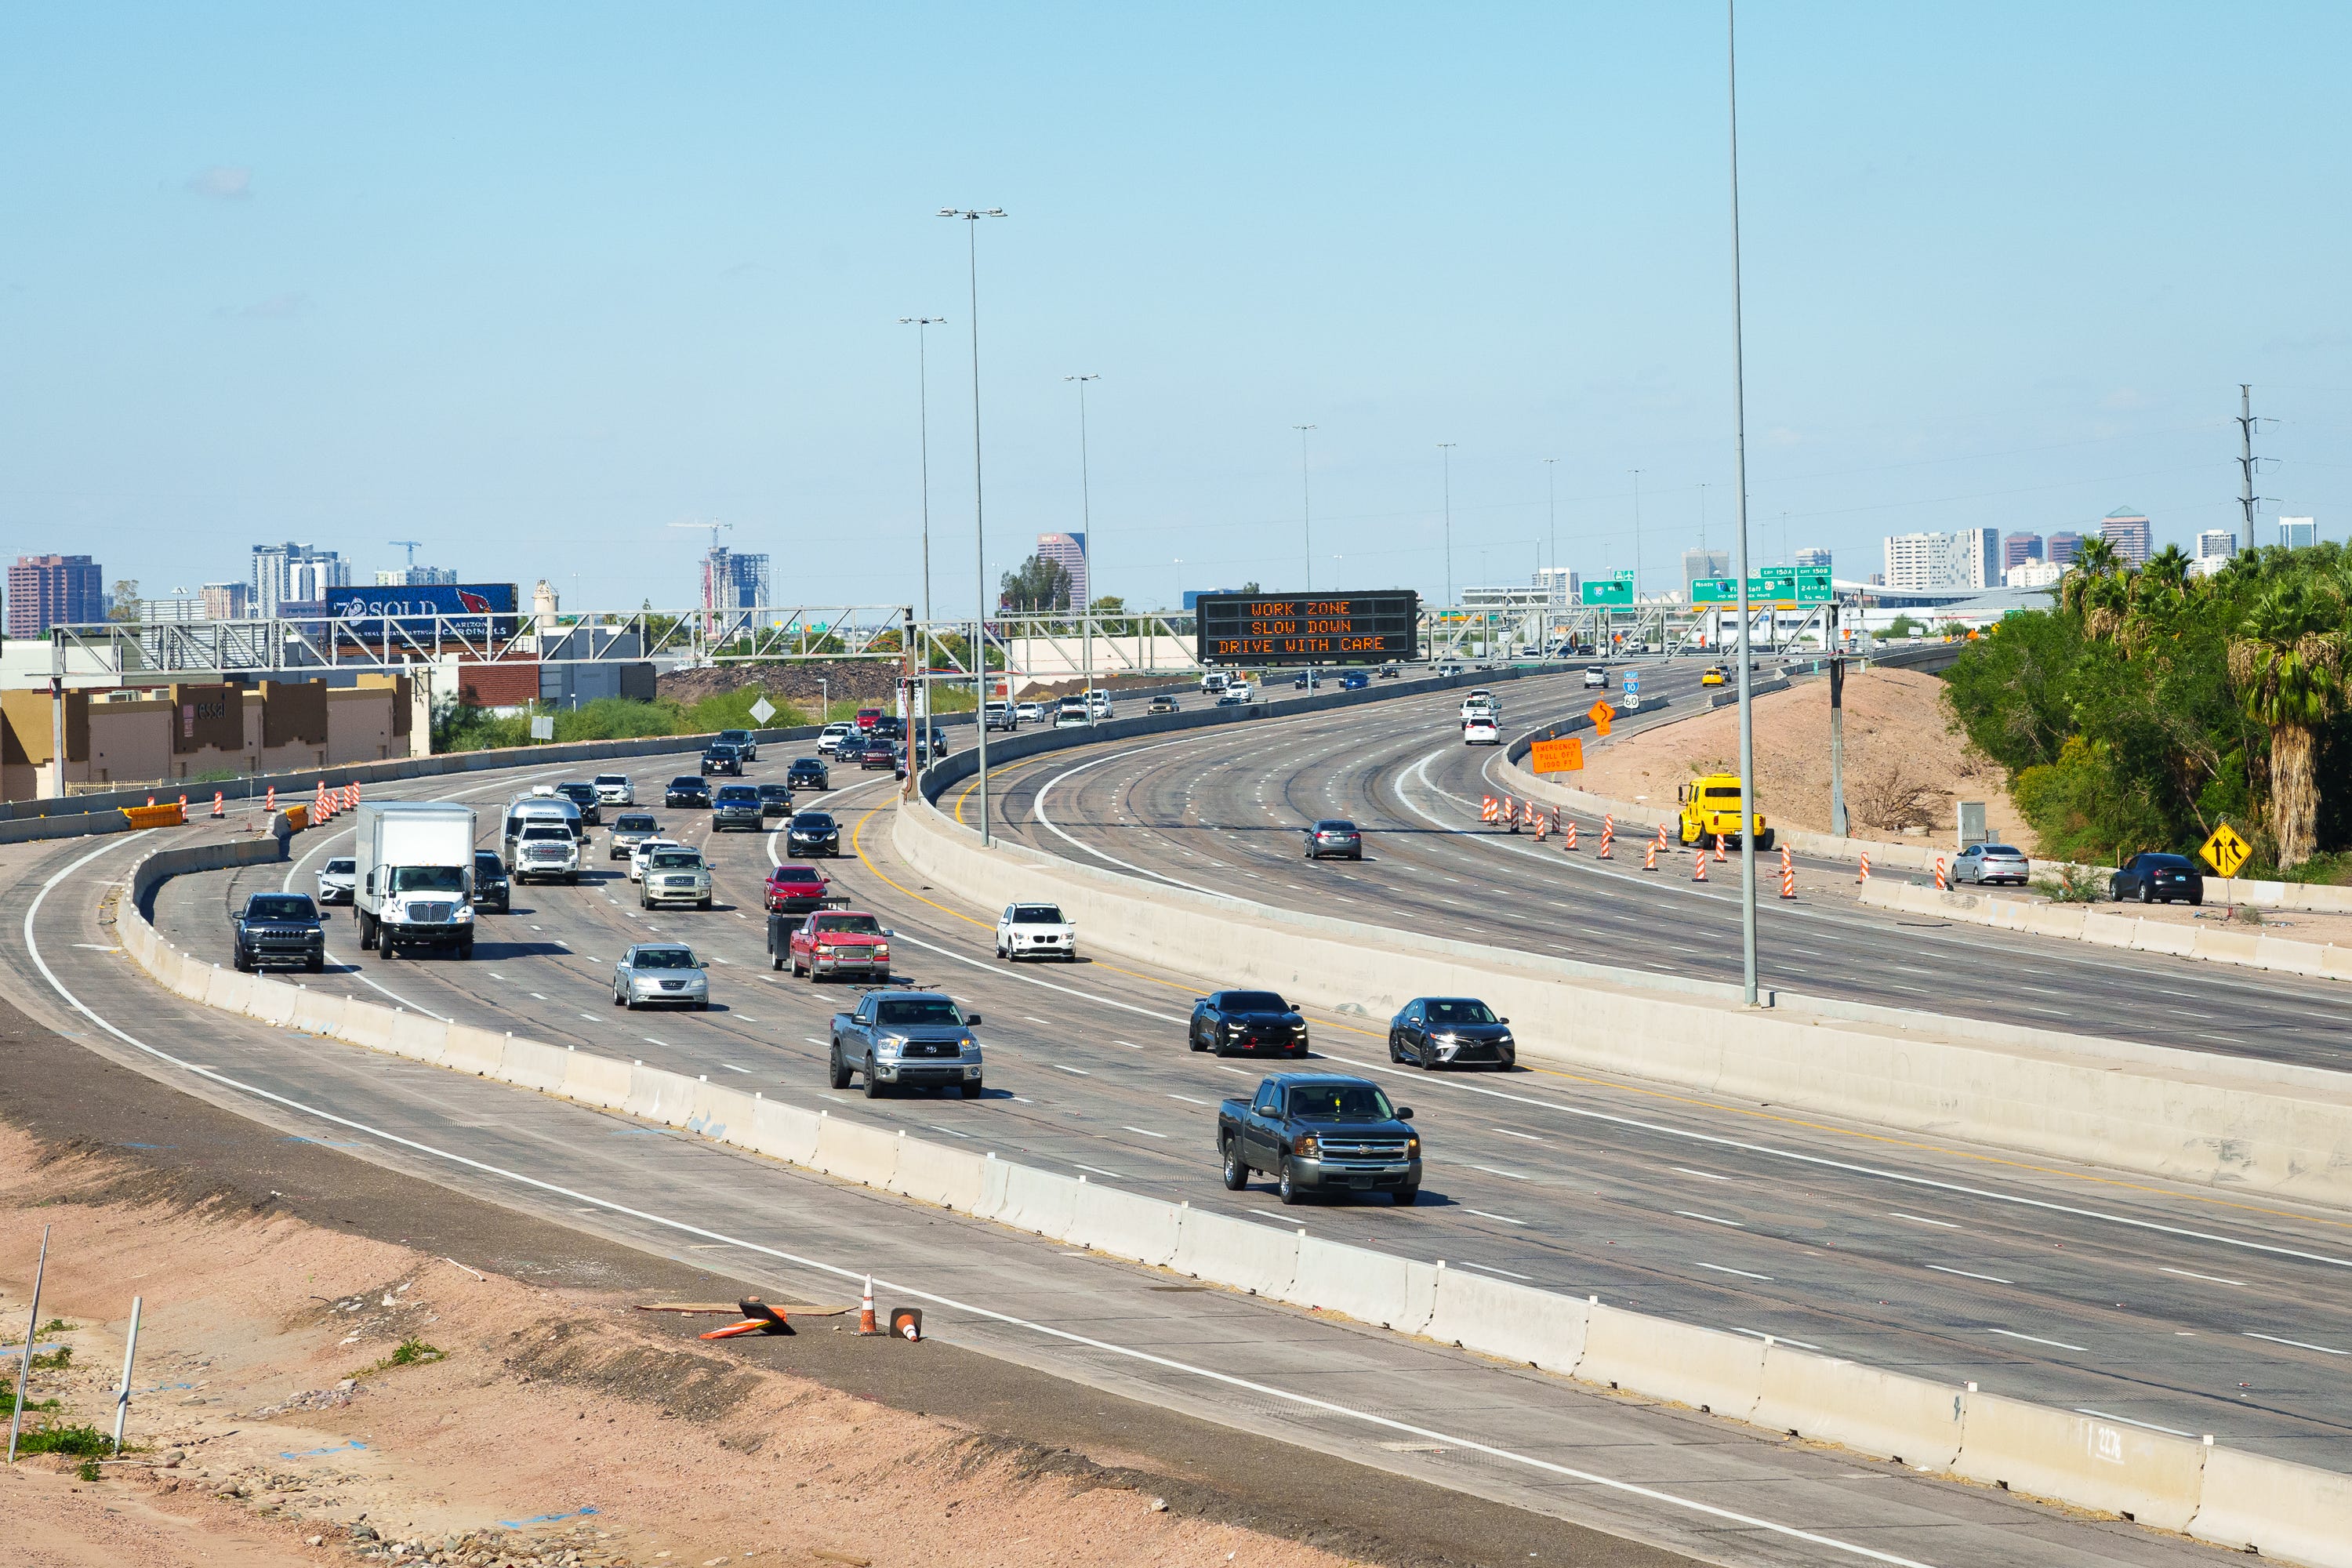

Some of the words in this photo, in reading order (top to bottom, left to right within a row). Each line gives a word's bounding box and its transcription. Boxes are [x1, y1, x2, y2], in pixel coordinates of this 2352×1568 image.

[1251, 603, 1295, 616] WORK
[1307, 601, 1350, 615] ZONE
[441, 627, 507, 636] CARDINLS
[1252, 621, 1295, 634] SLOW
[1308, 619, 1351, 633] DOWN
[1218, 640, 1273, 653] DRIVE
[1285, 638, 1329, 652] WITH
[1341, 637, 1385, 651] CARE
[1625, 697, 1637, 706] 60
[1536, 742, 1577, 752] EMERGENCY
[2098, 1427, 2122, 1460] 2276
